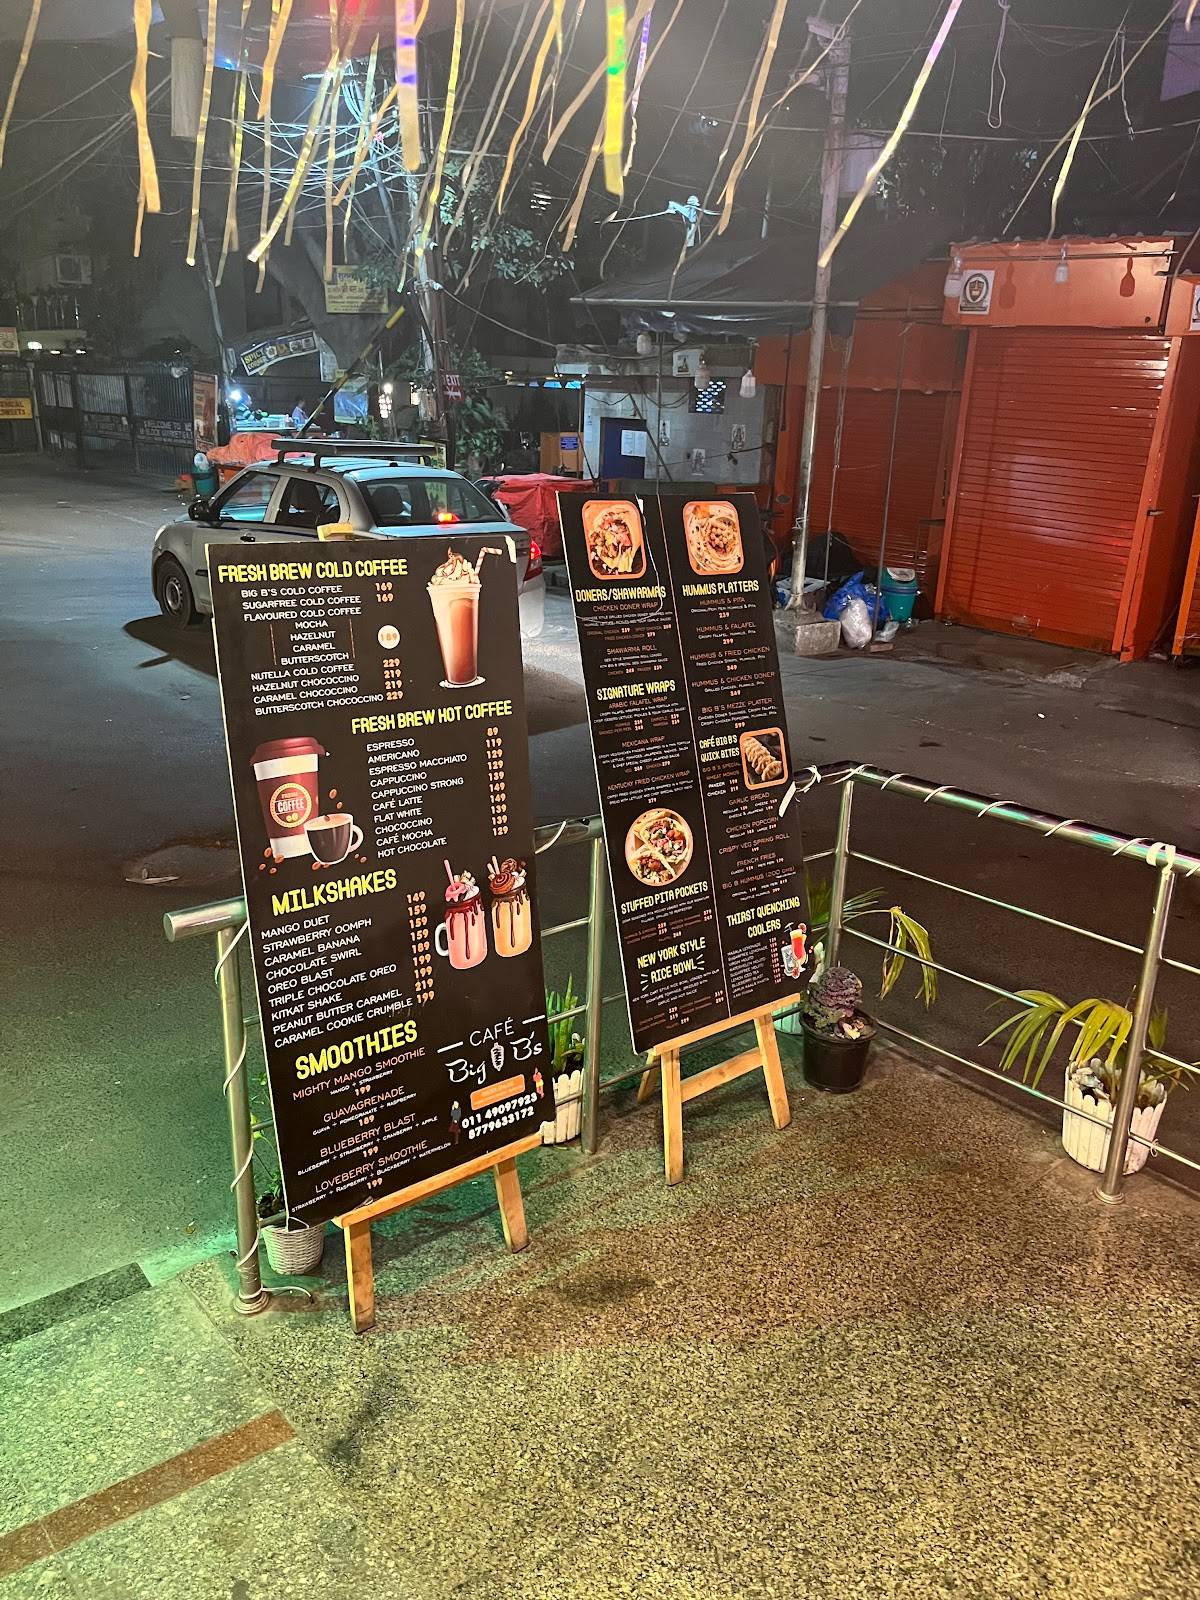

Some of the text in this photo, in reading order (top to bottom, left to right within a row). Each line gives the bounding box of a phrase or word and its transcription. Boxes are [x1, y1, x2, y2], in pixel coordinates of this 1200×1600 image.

[445, 374, 461, 386] EXIT
[218, 559, 408, 583] FRESH BREW COLD COFFEE
[241, 589, 258, 598] BIG
[280, 587, 305, 596] COLD
[308, 585, 343, 594] COFFEE
[375, 582, 392, 591] 169
[682, 580, 759, 596] HUMMUS PLATTERS
[242, 593, 393, 610] SUGARFREE COLD COFFEE 169
[244, 607, 361, 621] FLAVOURED COLD COFFEE
[290, 631, 336, 641] HAZELNUT
[295, 620, 328, 629] MOCHA
[281, 652, 349, 665] BUTTERSCOTCH
[293, 642, 336, 652] CARAMEL
[251, 658, 400, 680] NUTELLA COLD COFFEE 229
[252, 669, 401, 692] HAZELNUT CHOCOCCINO 219
[254, 680, 402, 704] CARAMEL CHOCOCCINO 219
[255, 691, 403, 715] BUTTERSCOTCH CHOCOCCINO 229
[597, 680, 675, 700] SIGNATURE WRAPS
[352, 700, 512, 734] FRESH BREW HOT COFFEE
[367, 727, 498, 752] ESPRESSO 89
[368, 738, 502, 763] AMERICANO 119
[699, 735, 715, 749] CAFÉ
[369, 749, 502, 775] ESPRESSO MACCHIATO 129
[701, 751, 720, 762] QUICK
[721, 747, 739, 758] BITES
[370, 760, 503, 787] CAPPUCCINO 129
[371, 771, 504, 799] CAPPUCCINO STRONG 139
[277, 798, 305, 813] COFFEE
[373, 782, 505, 811] CAFÉ LATTE 149
[374, 793, 506, 823] FLAT WHITE 149
[375, 804, 506, 834] CHOCOCCINO 139
[376, 815, 507, 846] CAFÉ MOCHA 139
[378, 826, 508, 858] HOT CHOCOLATE 129
[272, 869, 397, 916] MILKSHAKES
[621, 896, 654, 914] STUFFED
[655, 890, 674, 904] PITA
[675, 881, 708, 899] POCKETS
[261, 891, 425, 939] MANGO DUET 149
[726, 908, 755, 926] THIRST
[757, 896, 800, 918] QUENCHING
[263, 904, 426, 953] STRAWBERRY OOMPH 159
[264, 916, 427, 966] CARAMEL BANANA 159
[748, 919, 781, 938] COOLERS
[266, 929, 428, 980] CHOCOLATE SWIRL 159
[637, 937, 706, 969] NEW YORK STYLE
[268, 941, 430, 994] OREO BLAST 189
[268, 954, 431, 1007] TRIPLE CHOCOLATE OREO 199
[651, 958, 698, 983] RICE BOWL
[271, 966, 432, 1021] KITKAT SHAKE 199
[273, 978, 433, 1034] PEANUT BUTTER CARAMEL 219
[275, 991, 434, 1048] CARAMEL COOKIE CRUMBLE 199
[470, 1017, 514, 1046] CAFÉ
[296, 1020, 417, 1079] SMOOTHIES
[293, 1047, 425, 1100] MIGHTY MANGO SMOOTHIE
[445, 1059, 486, 1084] Big
[355, 1085, 371, 1096] 199
[324, 1086, 406, 1122] GUAVAGRENADE
[462, 1113, 481, 1128] 011
[485, 1090, 538, 1119] 49097923
[359, 1115, 374, 1126] 189
[320, 1113, 415, 1157] BLUEBERRY BLAST
[363, 1146, 378, 1157] 199
[315, 1140, 429, 1193] LOVEBERRY SMOOTHIE
[367, 1178, 382, 1189] 199
